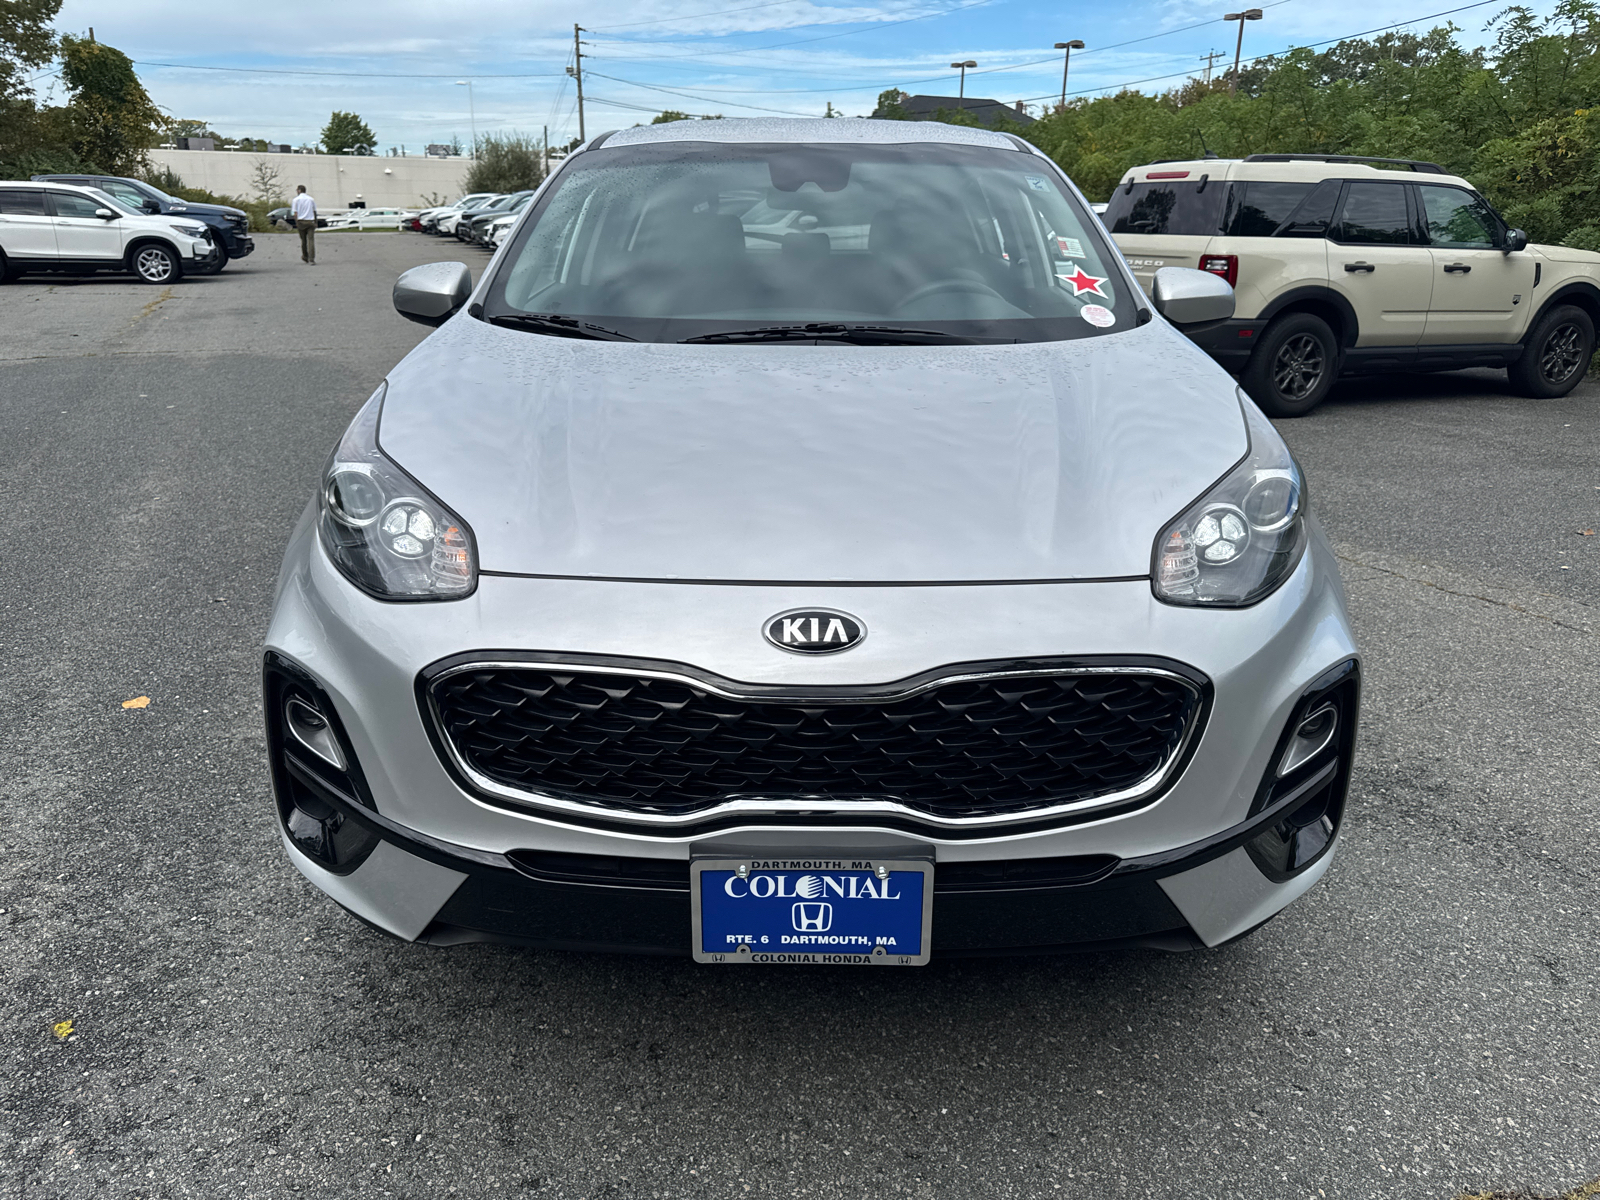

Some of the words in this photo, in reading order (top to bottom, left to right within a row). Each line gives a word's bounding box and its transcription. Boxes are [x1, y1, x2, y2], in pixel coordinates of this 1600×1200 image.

[782, 617, 849, 643] KIA
[751, 861, 847, 870] DARTMOUTH,
[851, 861, 873, 869] MA
[724, 875, 901, 899] COLONIAL
[726, 935, 757, 944] RTE.
[760, 935, 770, 944] 6
[781, 935, 872, 946] DARTMOUTH,
[876, 937, 897, 946] MA
[751, 953, 819, 963] COLONIAL
[823, 954, 872, 964] HONDA
